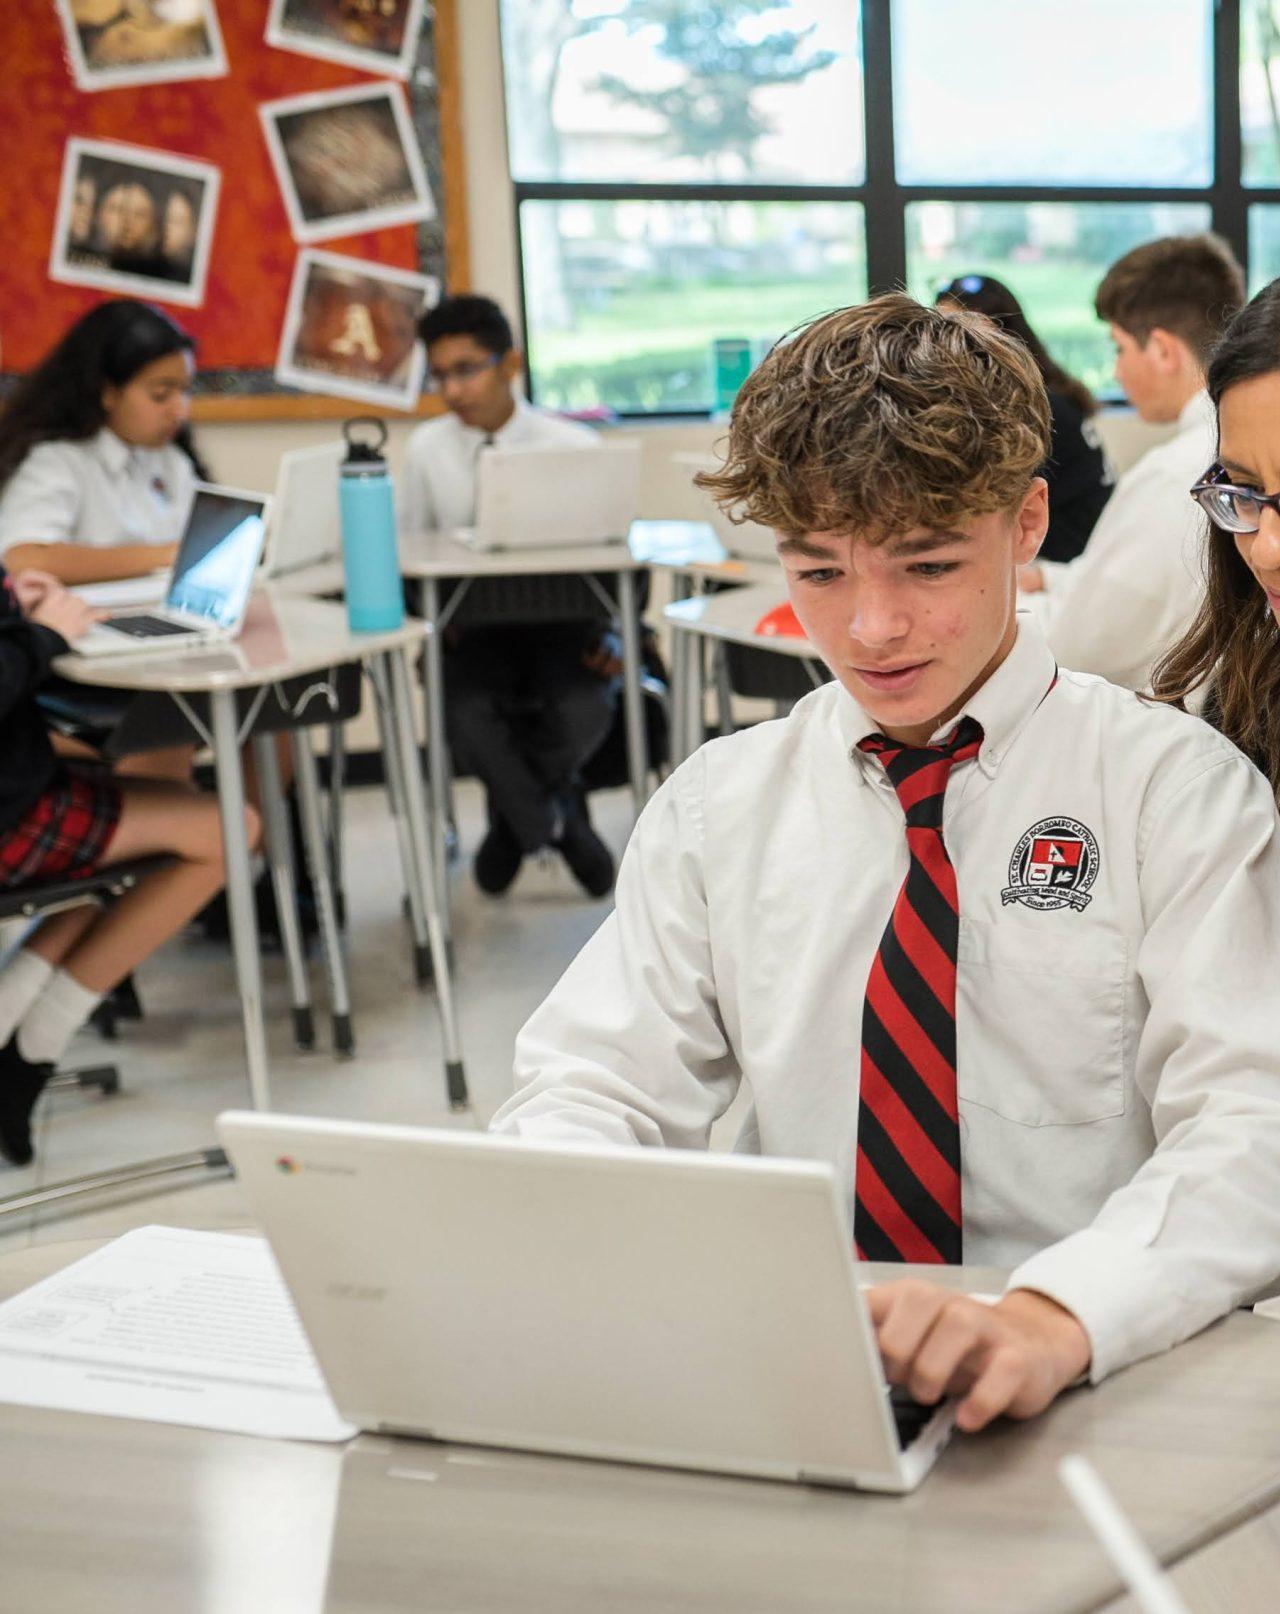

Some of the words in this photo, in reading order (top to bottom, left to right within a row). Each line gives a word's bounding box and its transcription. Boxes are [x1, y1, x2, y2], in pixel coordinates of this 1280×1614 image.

[327, 303, 381, 361] A
[1012, 837, 1031, 871] CHARLES
[1072, 823, 1097, 857] CATHOLIC
[1081, 857, 1097, 889] SCHOOL
[1026, 897, 1046, 907] Since
[1058, 889, 1069, 897] and
